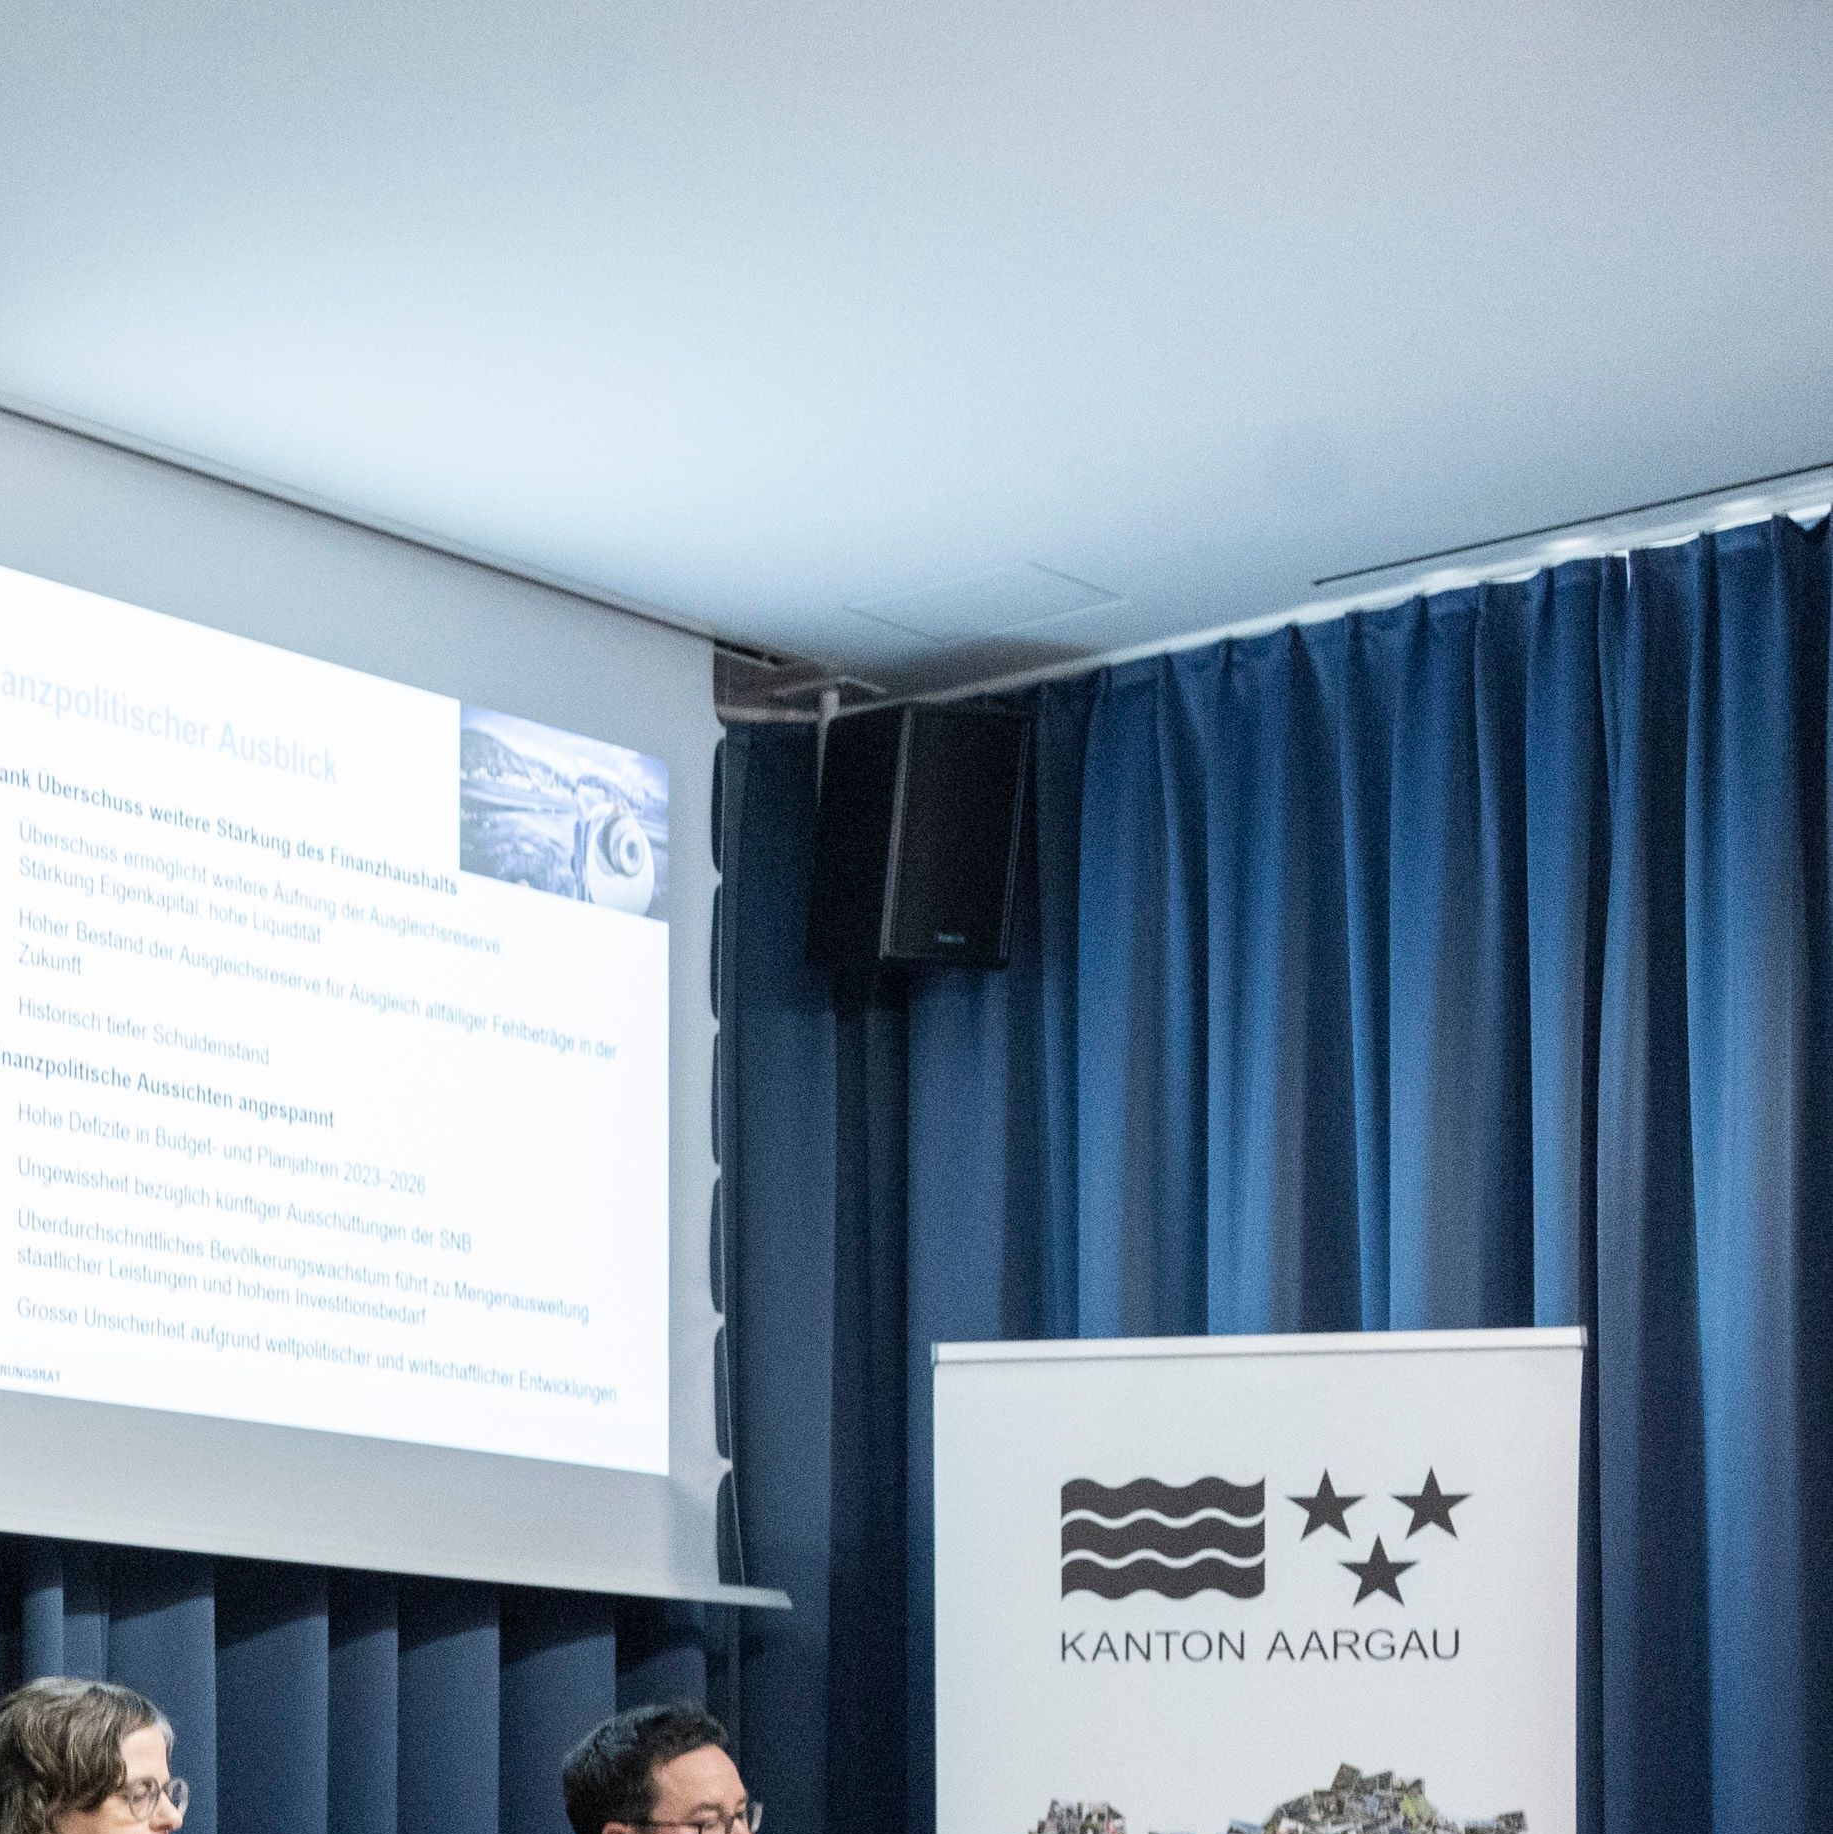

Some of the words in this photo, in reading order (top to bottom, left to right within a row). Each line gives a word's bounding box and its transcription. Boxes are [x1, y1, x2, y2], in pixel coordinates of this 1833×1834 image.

[216, 719, 338, 784] Ausblick
[148, 804, 212, 835] weitere
[295, 838, 326, 863] des
[329, 844, 459, 897] Finanzhaushalts
[208, 900, 249, 927] hohe
[211, 872, 269, 898] weitere
[341, 901, 365, 921] der
[18, 941, 82, 976] Zukunft
[18, 907, 69, 937] Hoher
[75, 919, 144, 955] Bestand
[148, 938, 174, 960] der
[179, 943, 322, 994] Ausgleichsreserve
[349, 982, 421, 1014] Ausgleich
[578, 1036, 592, 1055] in
[594, 1038, 618, 1061] der
[18, 994, 101, 1031] Historisch
[106, 1014, 147, 1040] tiefer
[152, 1023, 270, 1066] Schuldenstand
[135, 1070, 234, 1109] Aussichten
[237, 1094, 335, 1130] angespannt
[17, 1101, 63, 1129] Hohe
[69, 1110, 131, 1141] Defizite
[135, 1127, 150, 1144] in
[155, 1124, 218, 1159] Budget-
[222, 1144, 253, 1164] und
[257, 1143, 339, 1178] Planjahren
[17, 1154, 130, 1194] Ungewissheit
[410, 1224, 434, 1246] der
[439, 1227, 473, 1255] SNB
[17, 1245, 103, 1275] staatlicher
[108, 1257, 198, 1293] Leistungen
[202, 1275, 233, 1296] und
[236, 1277, 291, 1304] hohem
[295, 1286, 427, 1326] Investitionsbedarf
[432, 1279, 450, 1299] zu
[453, 1278, 590, 1327] Mengenausweitung
[16, 1296, 79, 1325] Grosse
[83, 1306, 186, 1340] Unsicherheit
[190, 1324, 261, 1352] aufgrund
[264, 1336, 371, 1367] weltpolitischer
[376, 1352, 405, 1373] und
[408, 1357, 514, 1388] wirtschaftlicher
[518, 1368, 618, 1407] Entwicklungen
[1060, 1629, 1246, 1663] KANTON
[1265, 1627, 1462, 1662] AARGAU
